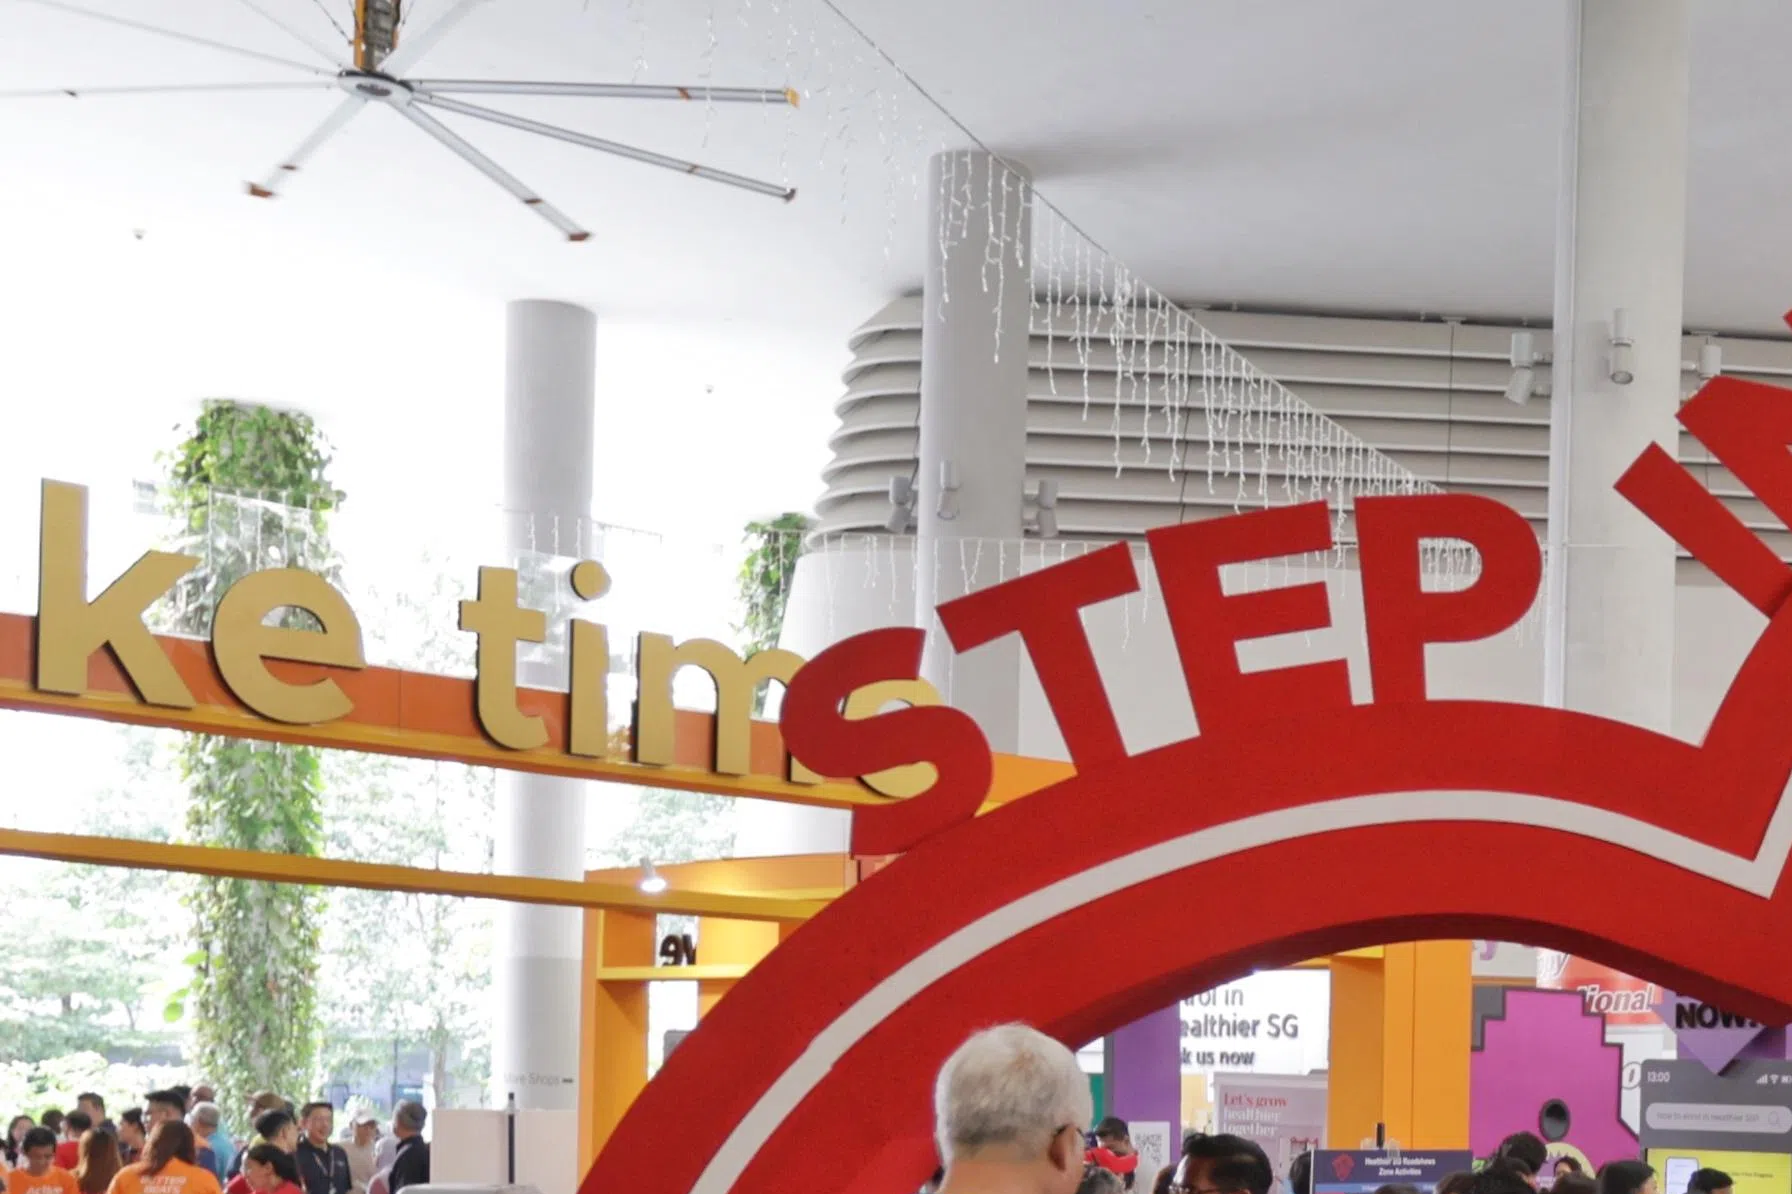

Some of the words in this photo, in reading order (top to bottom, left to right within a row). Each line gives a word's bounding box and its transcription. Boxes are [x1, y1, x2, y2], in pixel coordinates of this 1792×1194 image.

[36, 477, 367, 725] ke
[779, 493, 1543, 856] STEP
[1224, 988, 1244, 1006] in
[1577, 983, 1654, 1013] ional
[1675, 1002, 1758, 1029] NOW
[1267, 1013, 1298, 1038] SG
[1197, 1050, 1215, 1065] us
[1219, 1050, 1255, 1065] now
[1647, 1071, 1671, 1083] 13:00
[1223, 1092, 1253, 1107] Let's
[1255, 1096, 1288, 1109] grow
[1223, 1107, 1281, 1122] healthier
[1223, 1122, 1279, 1137] together
